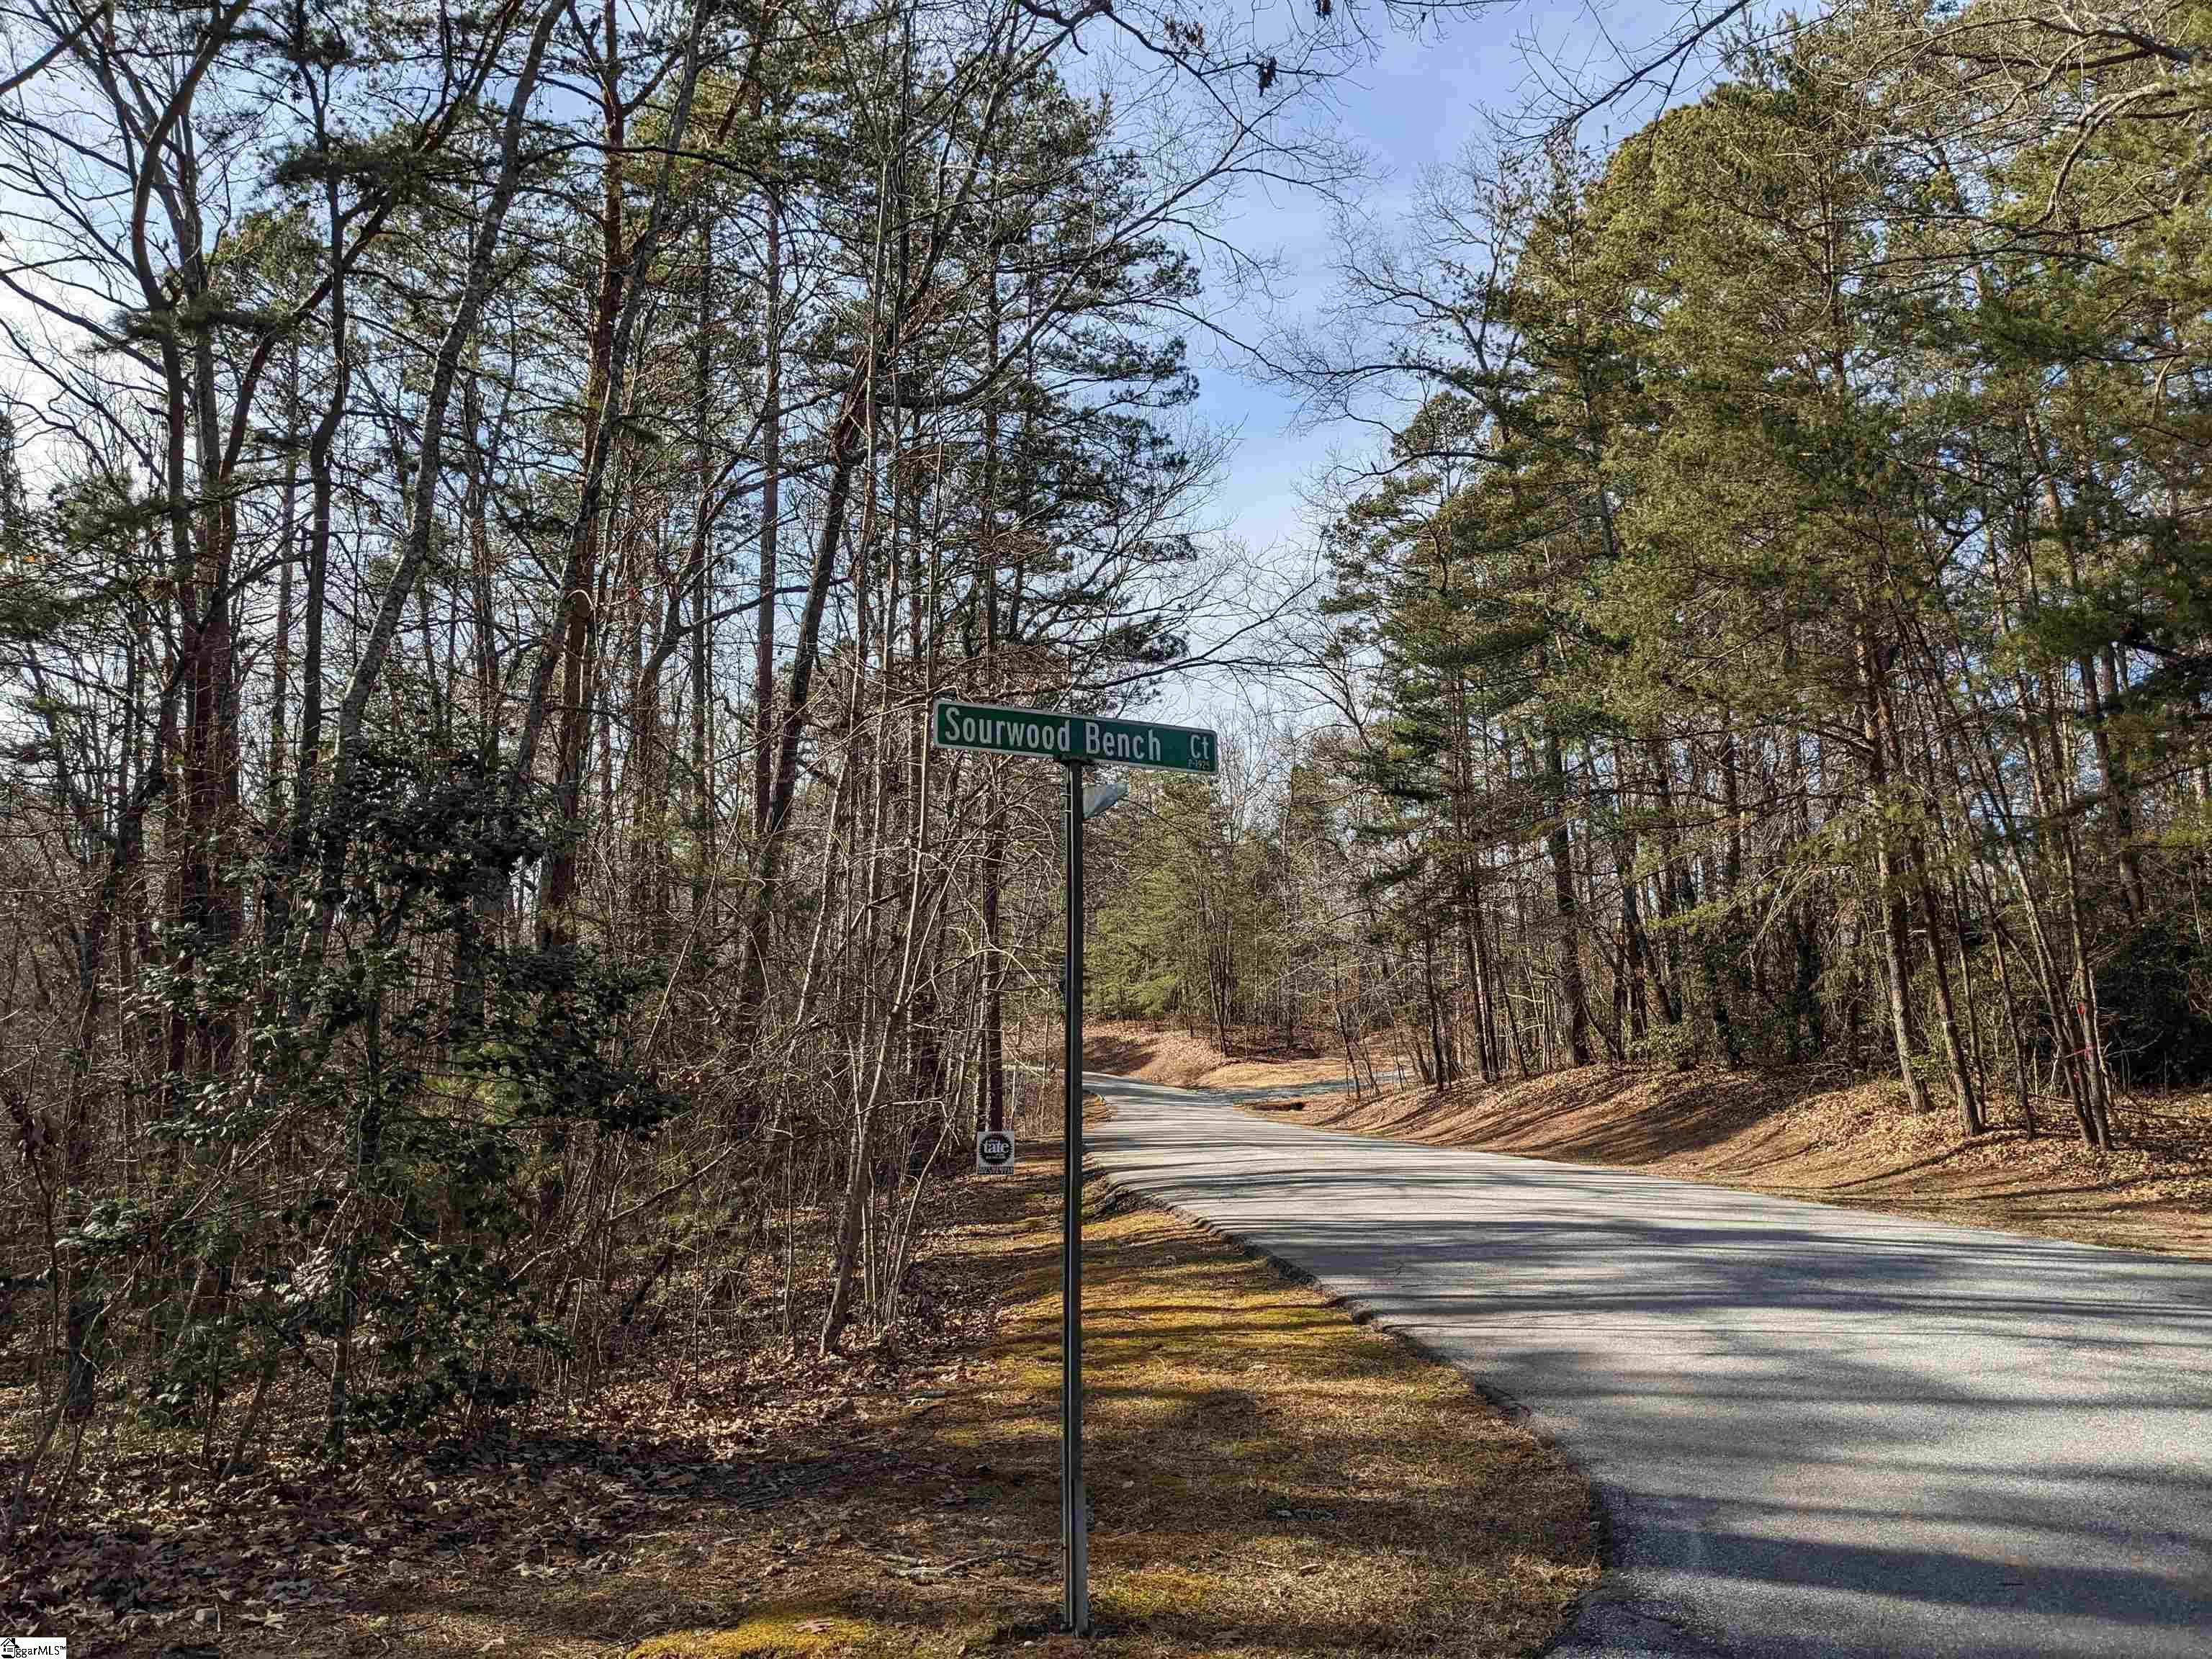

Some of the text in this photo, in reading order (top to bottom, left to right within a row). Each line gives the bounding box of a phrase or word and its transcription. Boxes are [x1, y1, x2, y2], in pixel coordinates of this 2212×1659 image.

[945, 707, 1209, 761] Sourwood Bench Ct
